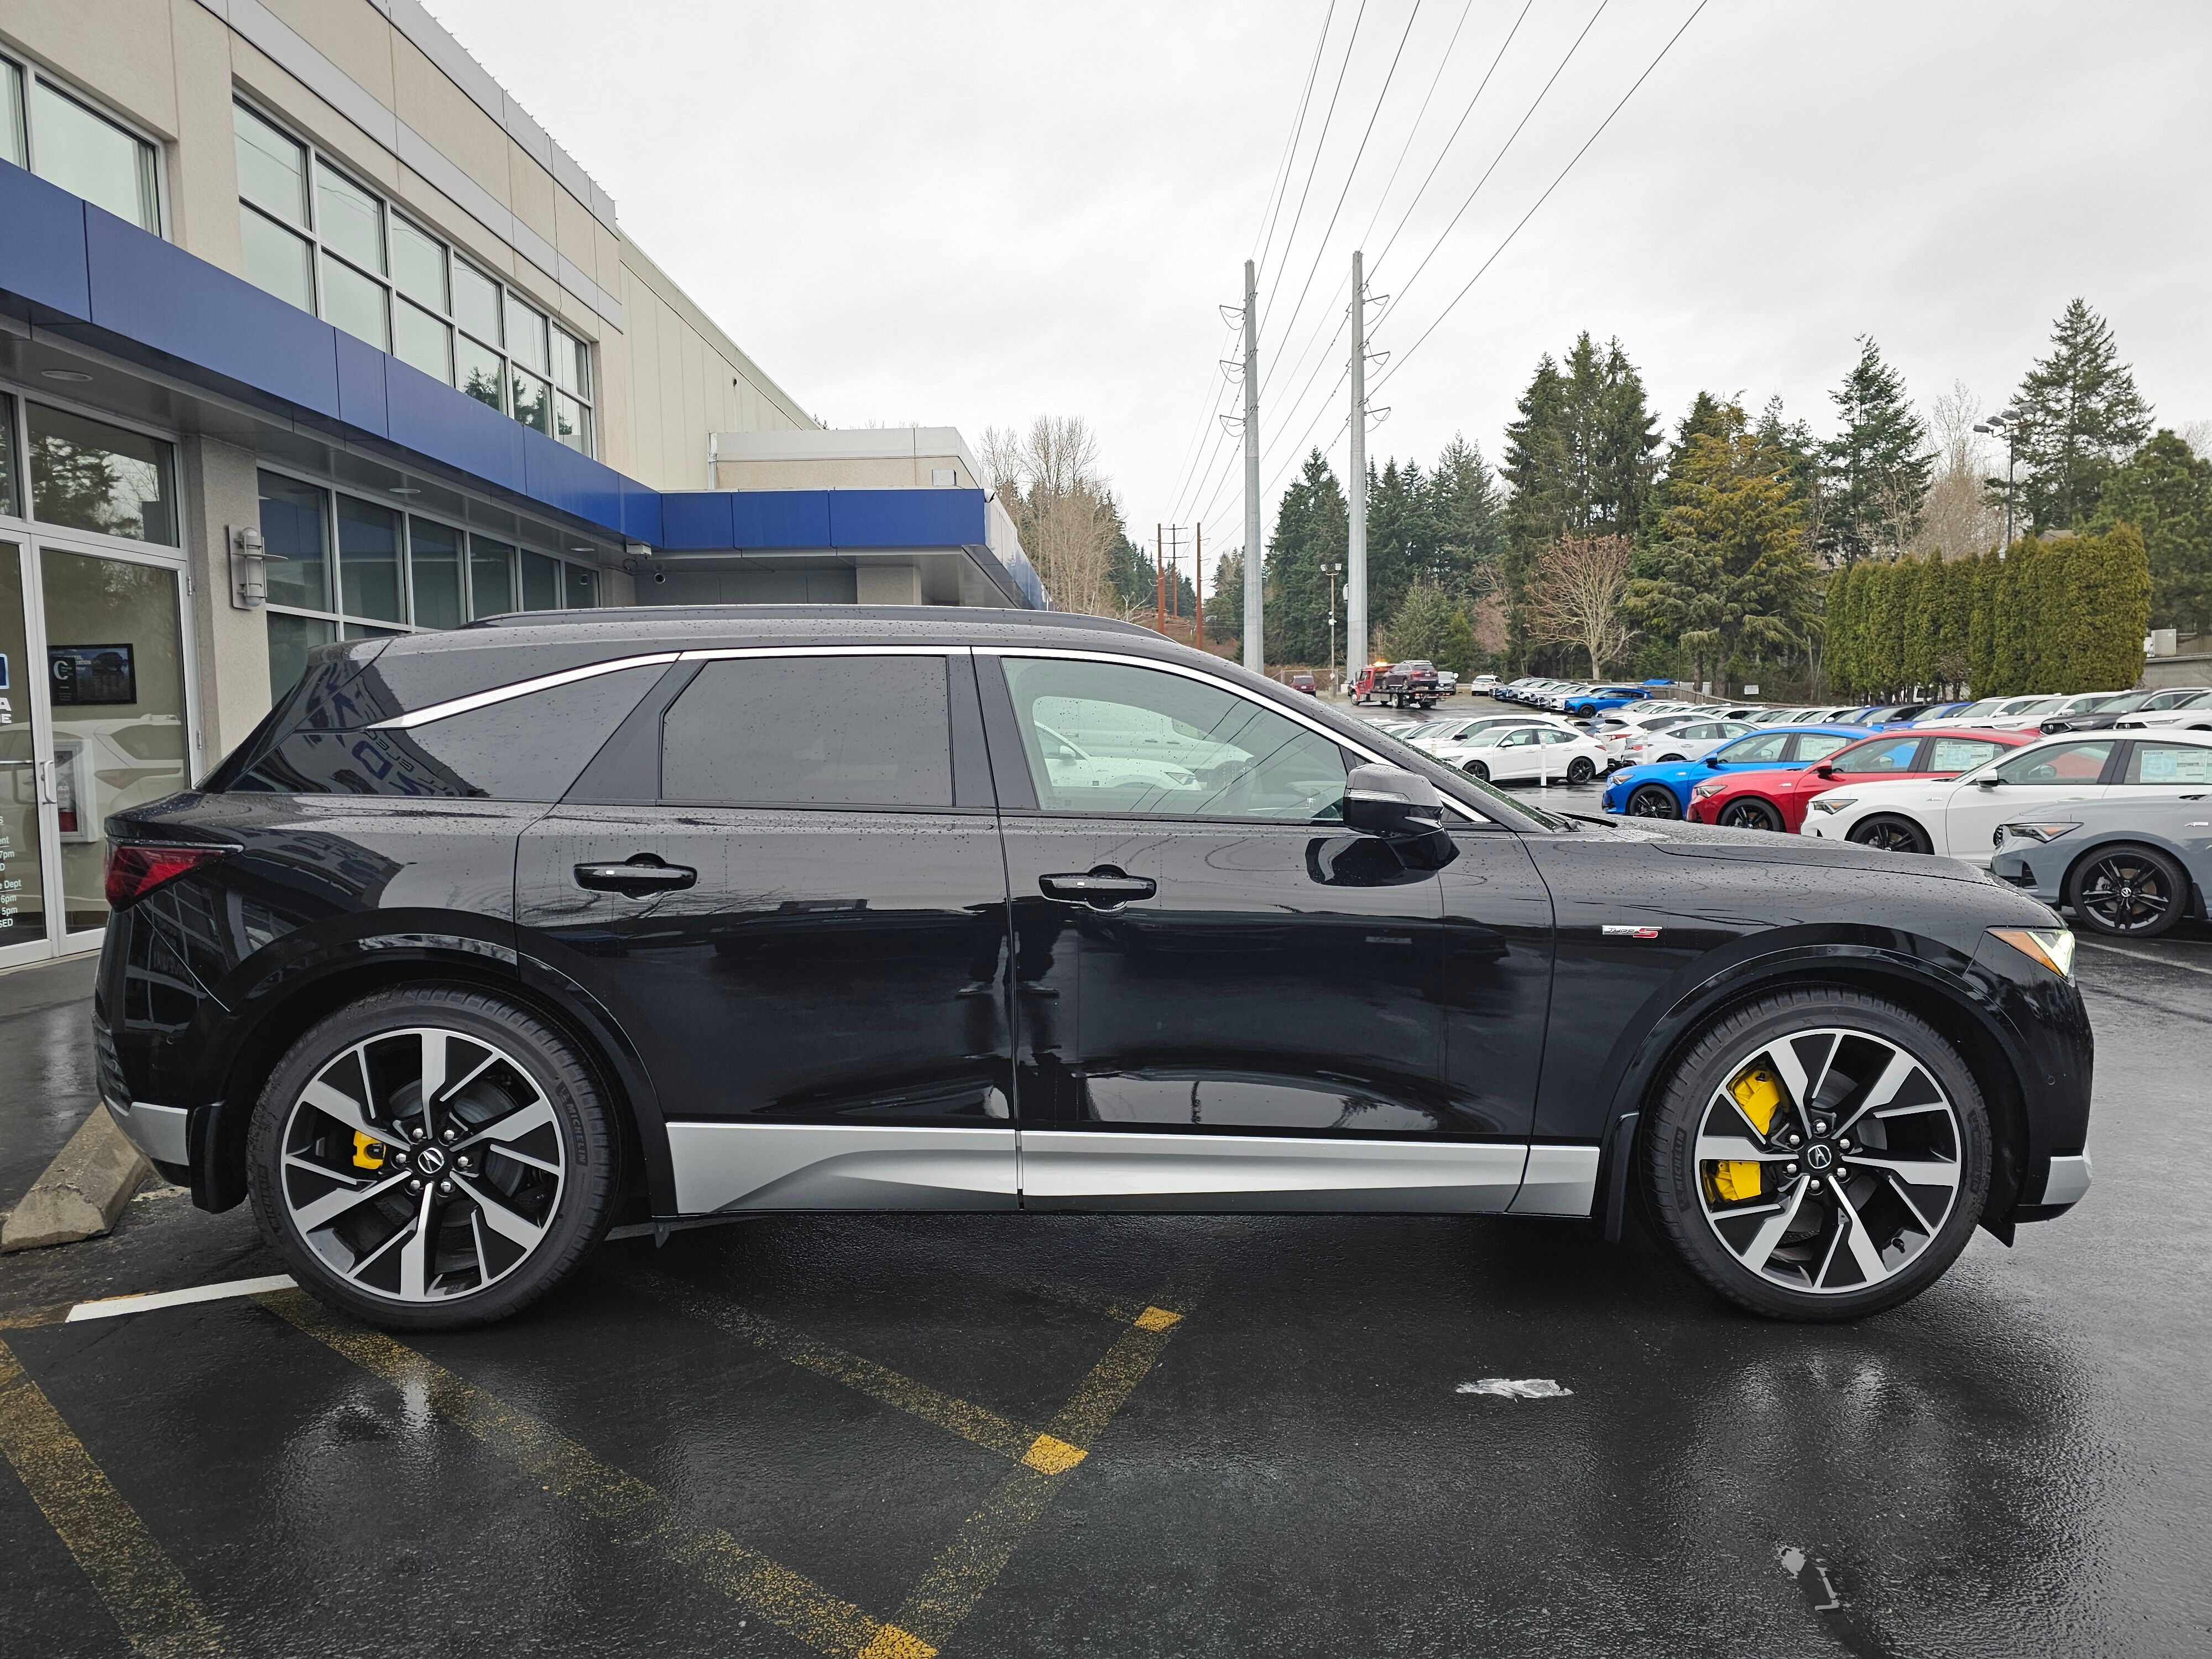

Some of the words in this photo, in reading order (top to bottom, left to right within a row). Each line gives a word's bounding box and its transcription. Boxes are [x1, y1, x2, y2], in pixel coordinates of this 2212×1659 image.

[0, 713, 12, 723] E
[4, 879, 22, 889] Dept
[1, 895, 17, 905] 6pm
[2, 907, 18, 916] 5pm
[566, 1103, 586, 1162] MICHELIN
[1674, 1131, 1684, 1191] MICHELIN
